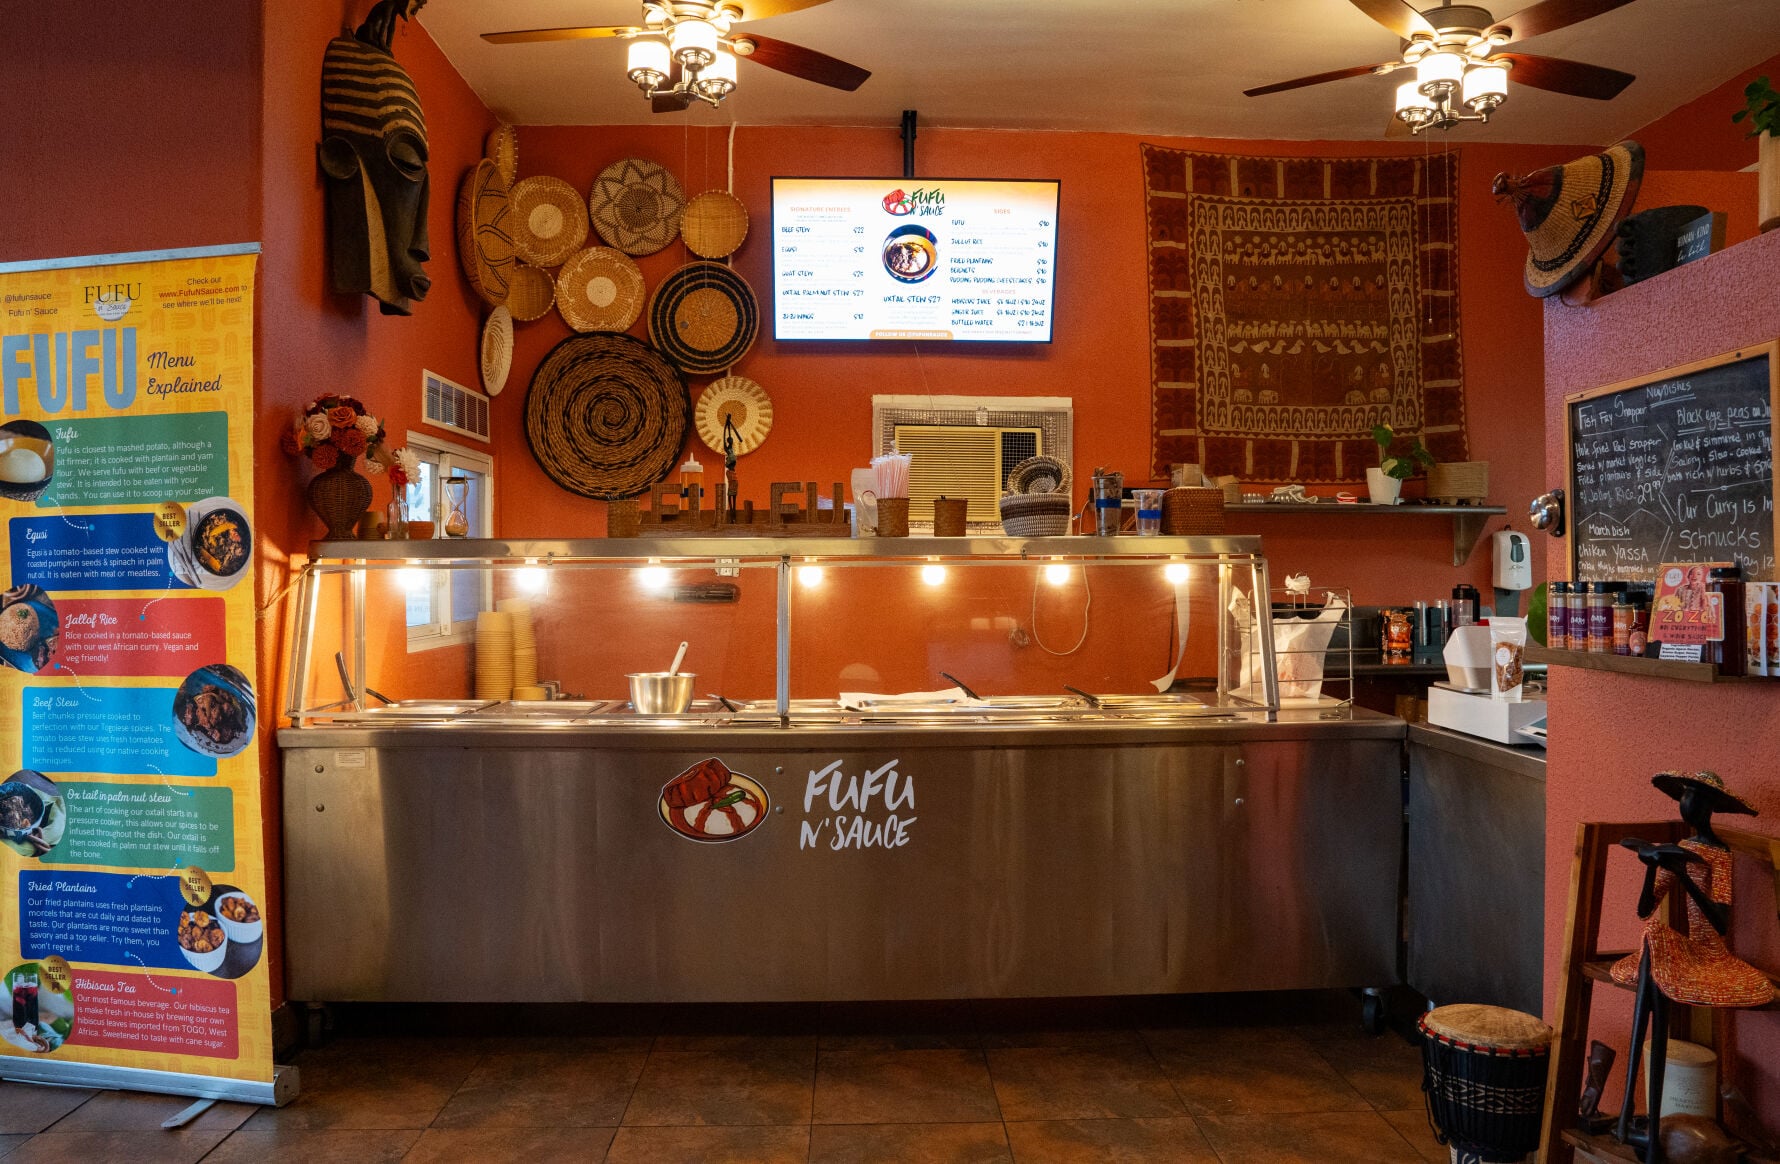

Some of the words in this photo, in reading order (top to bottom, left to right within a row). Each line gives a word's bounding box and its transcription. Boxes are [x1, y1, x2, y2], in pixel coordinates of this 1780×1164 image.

[912, 188, 945, 204] FUFU
[919, 206, 945, 216] SAUCE
[187, 277, 208, 286] Check
[210, 276, 221, 284] out
[4, 292, 52, 302] @fufunsauce
[84, 283, 142, 303] FUFU
[159, 285, 240, 299] www.FufuNSauce.com
[177, 299, 198, 308] where
[199, 297, 215, 307] we'll
[216, 296, 225, 305] be
[226, 296, 242, 304] next
[8, 309, 24, 317] Fufu
[34, 307, 58, 316] Sauce
[147, 351, 195, 370] Menu
[2, 327, 137, 415] FUFU
[147, 374, 222, 400] Explained
[1677, 407, 1702, 425] Black
[55, 427, 79, 443] Fufu
[57, 447, 72, 455] Fufu
[82, 446, 106, 454] closest
[116, 443, 145, 452] mashed
[146, 443, 171, 452] potato,
[173, 440, 206, 451] although
[57, 492, 81, 500] hands.
[83, 491, 98, 499] You
[142, 489, 163, 499] scoop
[164, 489, 173, 497] up
[175, 489, 192, 497] your
[193, 487, 214, 495] stew!
[1678, 493, 1699, 523] Our
[1706, 493, 1738, 525] Curry
[159, 520, 180, 528] SELLER
[162, 513, 176, 521] BEST
[26, 528, 48, 543] Egusi
[1589, 524, 1610, 536] March
[1612, 526, 1630, 536] Dish
[1679, 527, 1761, 550] Schnucks
[65, 613, 97, 628] Jallof
[99, 613, 118, 625] Rice
[65, 631, 81, 639] Rice
[83, 631, 107, 639] cooked
[122, 631, 170, 639] tomato-based
[113, 642, 138, 650] African
[163, 643, 183, 652] Vegan
[81, 654, 109, 663] friendly!
[32, 696, 52, 710] Beef
[56, 697, 79, 707] Stew
[804, 759, 915, 813] FUFU
[67, 789, 81, 800] Ox
[82, 789, 98, 800] tail
[99, 792, 106, 800] in
[107, 792, 130, 804] palm
[131, 793, 147, 803] nut
[149, 794, 172, 803] stew
[800, 817, 830, 850] N'
[830, 815, 917, 851] SAUCE
[28, 881, 53, 892] Fried
[55, 882, 97, 893] Plantains
[185, 884, 205, 893] SELLER
[28, 898, 43, 906] Our
[45, 898, 62, 907] fried
[63, 899, 94, 909] plantains
[111, 902, 129, 911] fresh
[130, 903, 162, 913] plantains
[45, 972, 66, 981] SELLER
[75, 978, 115, 992] Hibiscus
[117, 982, 136, 993] Tea
[77, 994, 91, 1002] Our
[92, 995, 109, 1003] most
[111, 996, 135, 1006] famous
[137, 998, 171, 1010] beverage.
[174, 1002, 187, 1010] Our
[189, 1002, 216, 1013] hibiscus
[218, 1006, 229, 1014] tea
